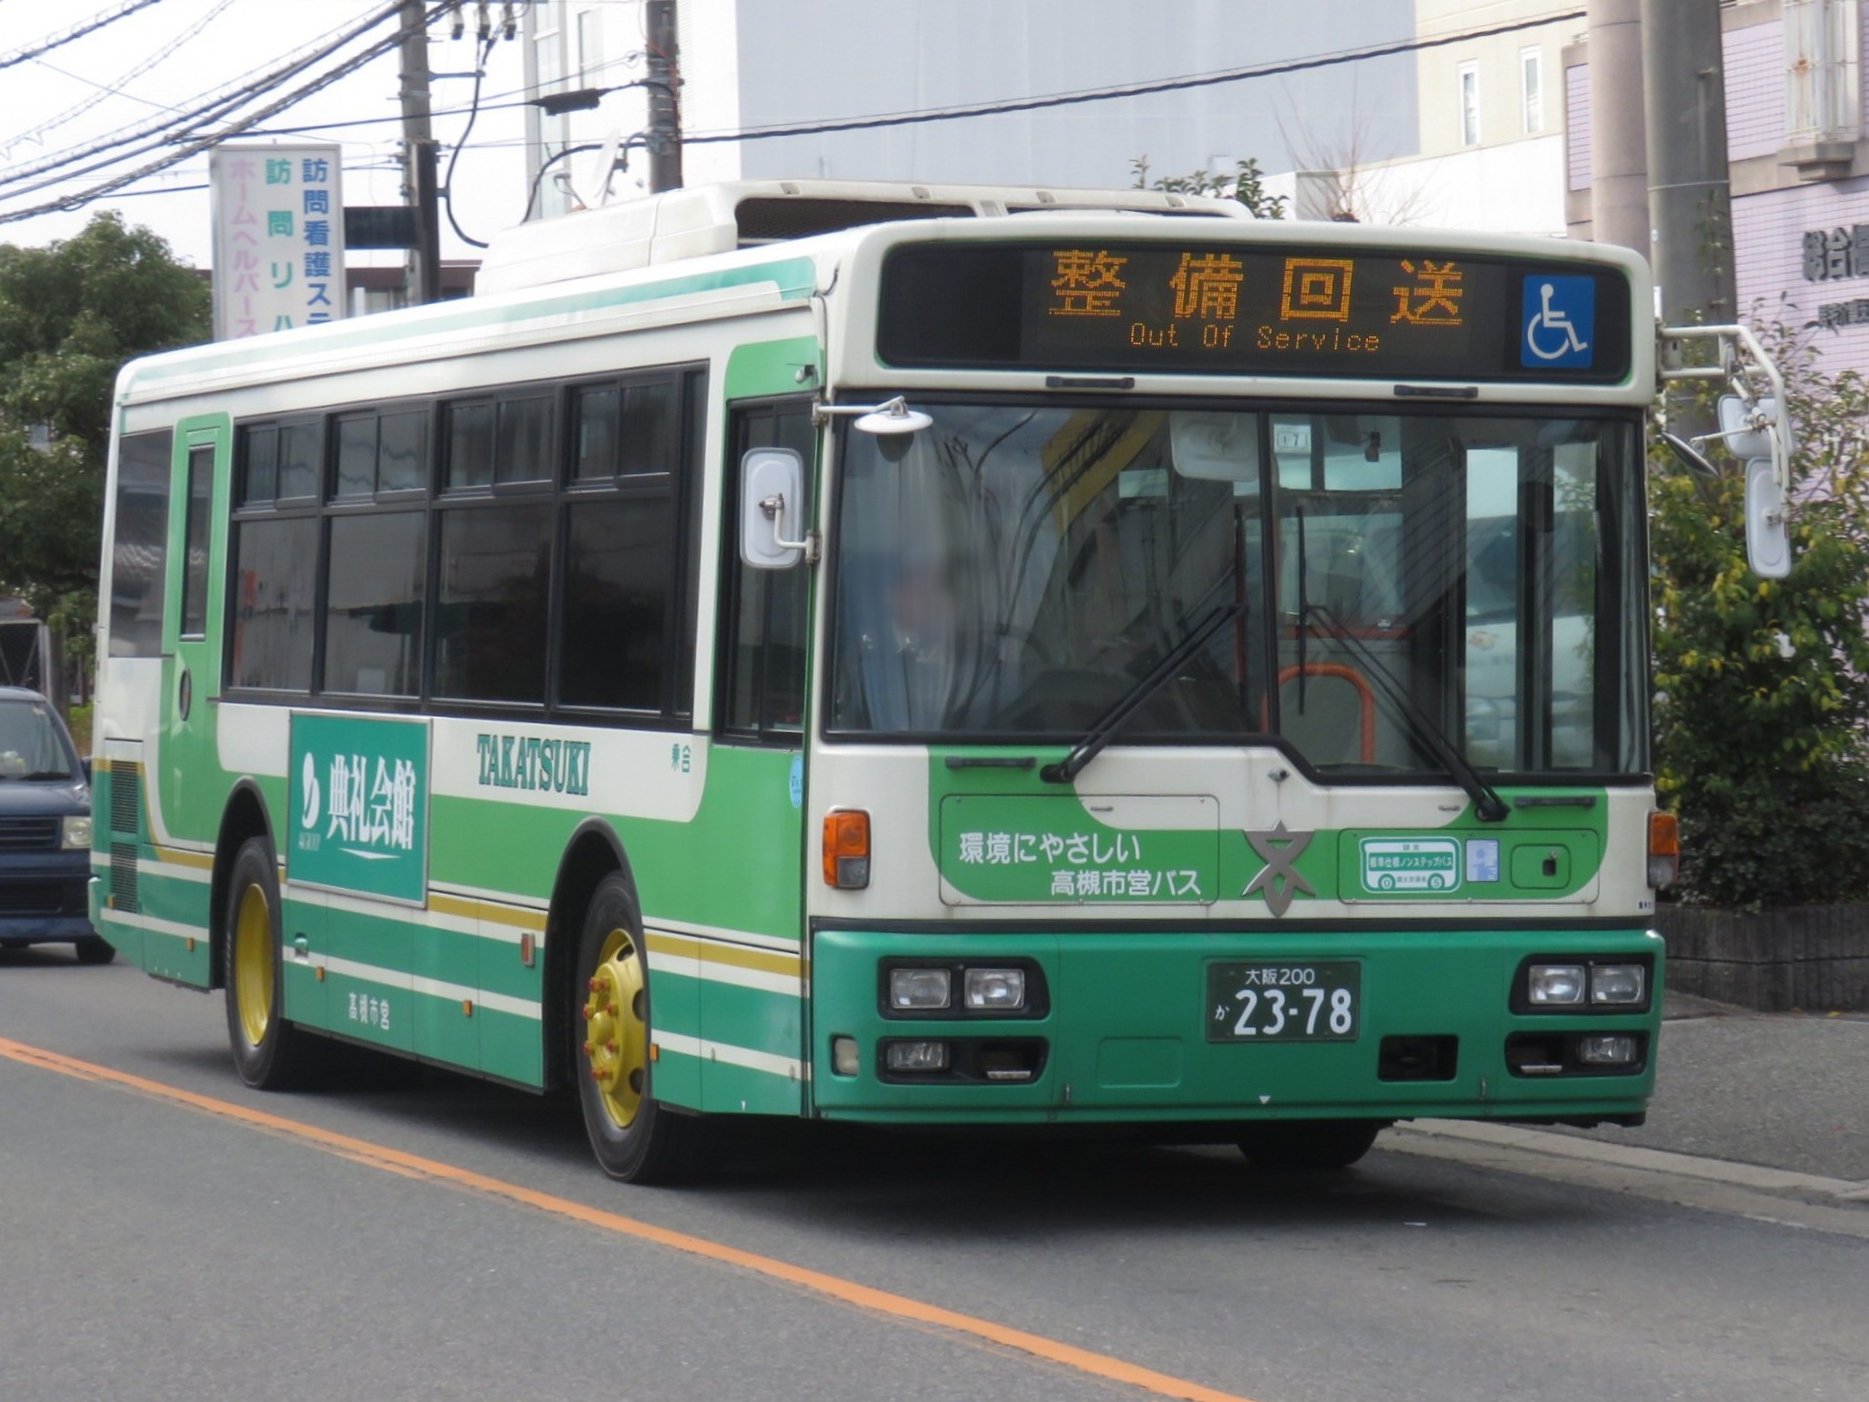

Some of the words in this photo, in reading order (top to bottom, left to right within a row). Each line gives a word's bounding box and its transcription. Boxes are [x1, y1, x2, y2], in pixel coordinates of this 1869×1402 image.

[1129, 322, 1179, 347] Out
[1203, 324, 1234, 348] Of
[1257, 325, 1380, 351] Service
[477, 733, 591, 796] TAKATSUKI
[326, 753, 416, 851] 典礼会館
[959, 832, 1141, 864] 環境にやさしい
[1050, 870, 1202, 897] 高槻市営バス
[1214, 1004, 1231, 1021] か
[1234, 988, 1353, 1036] 23-78
